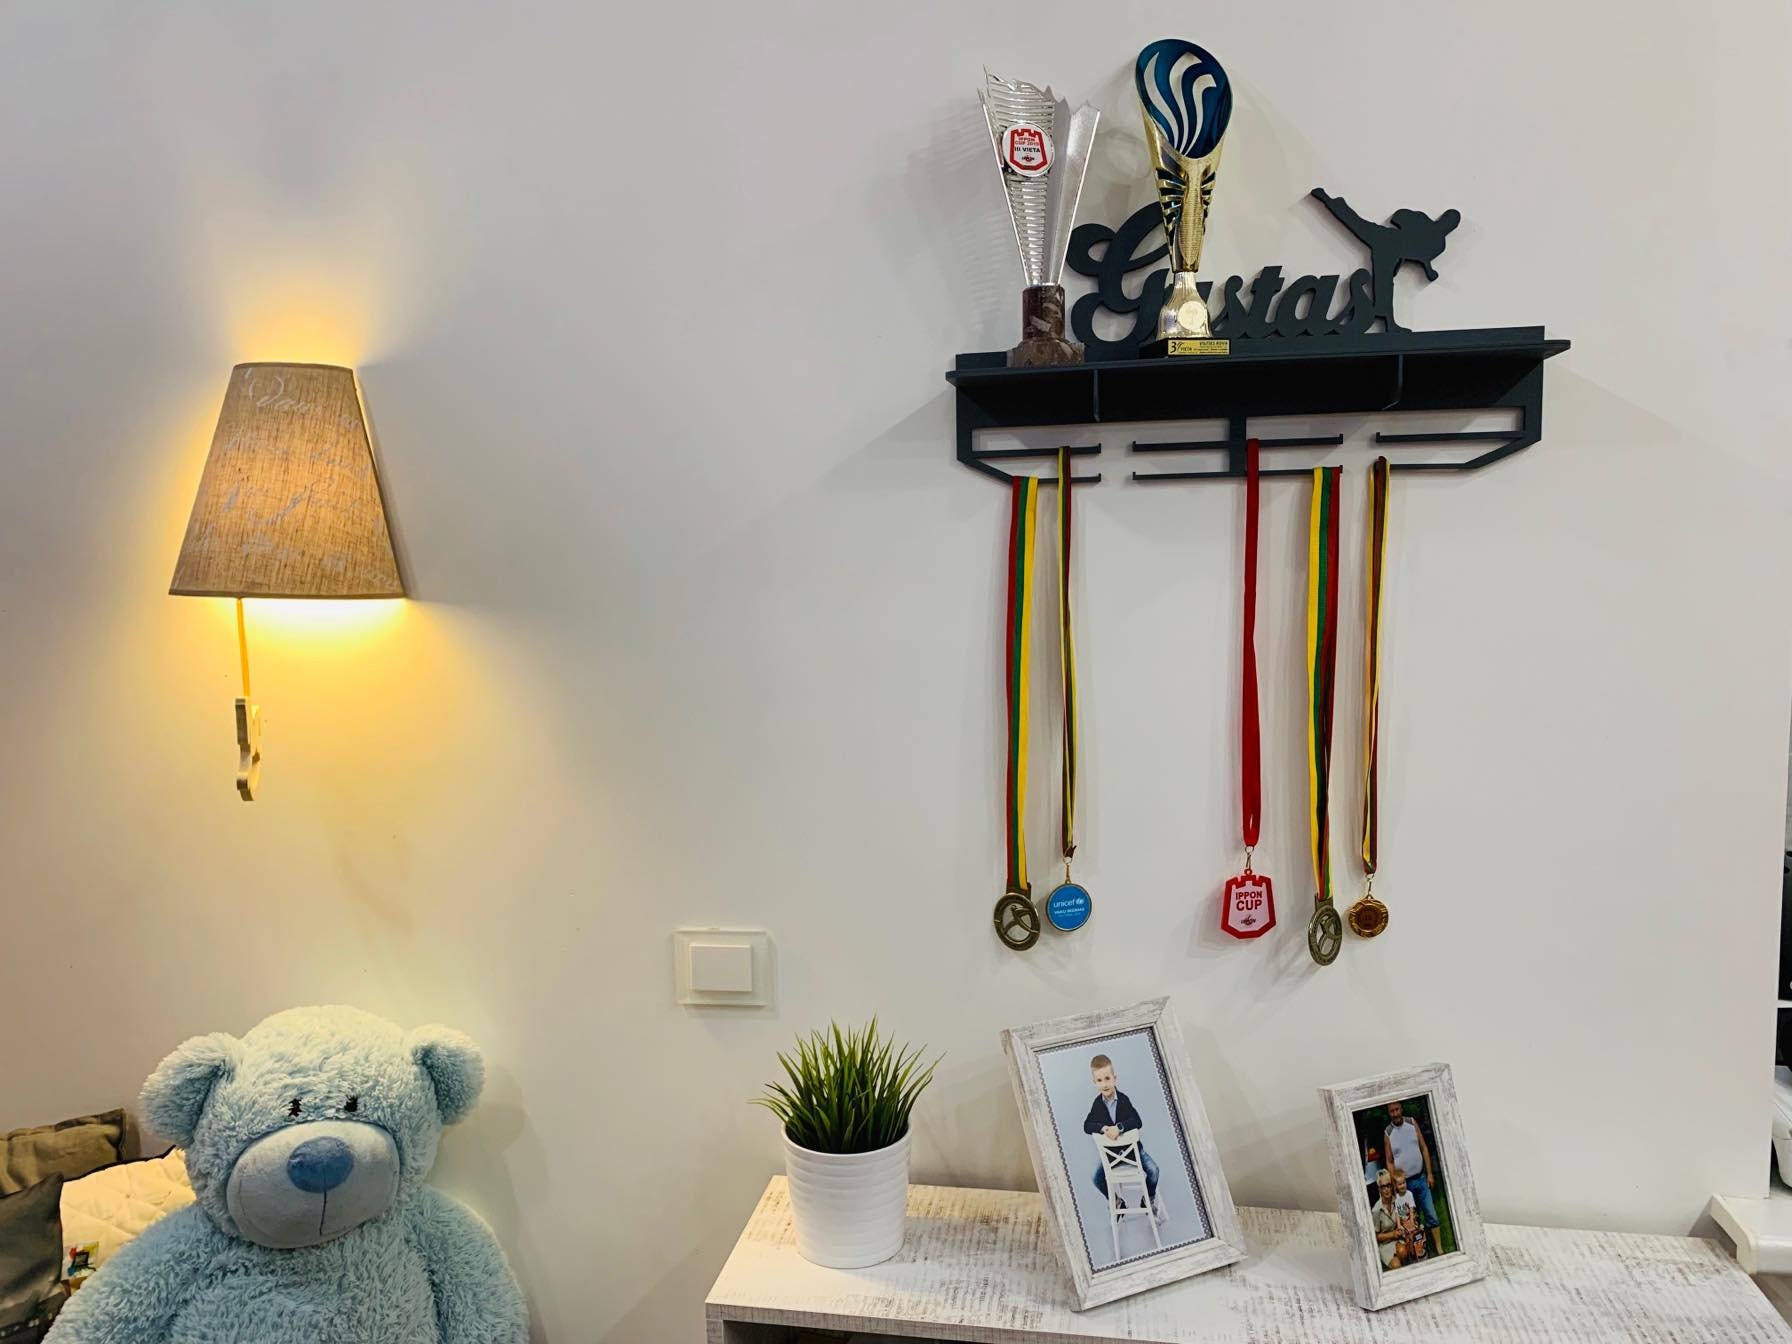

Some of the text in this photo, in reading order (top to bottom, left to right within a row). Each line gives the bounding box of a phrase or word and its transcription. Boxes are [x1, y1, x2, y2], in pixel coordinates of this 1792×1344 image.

[1235, 890, 1263, 901] IPPON
[1053, 897, 1075, 908] unicef
[1236, 899, 1263, 912] CUP
